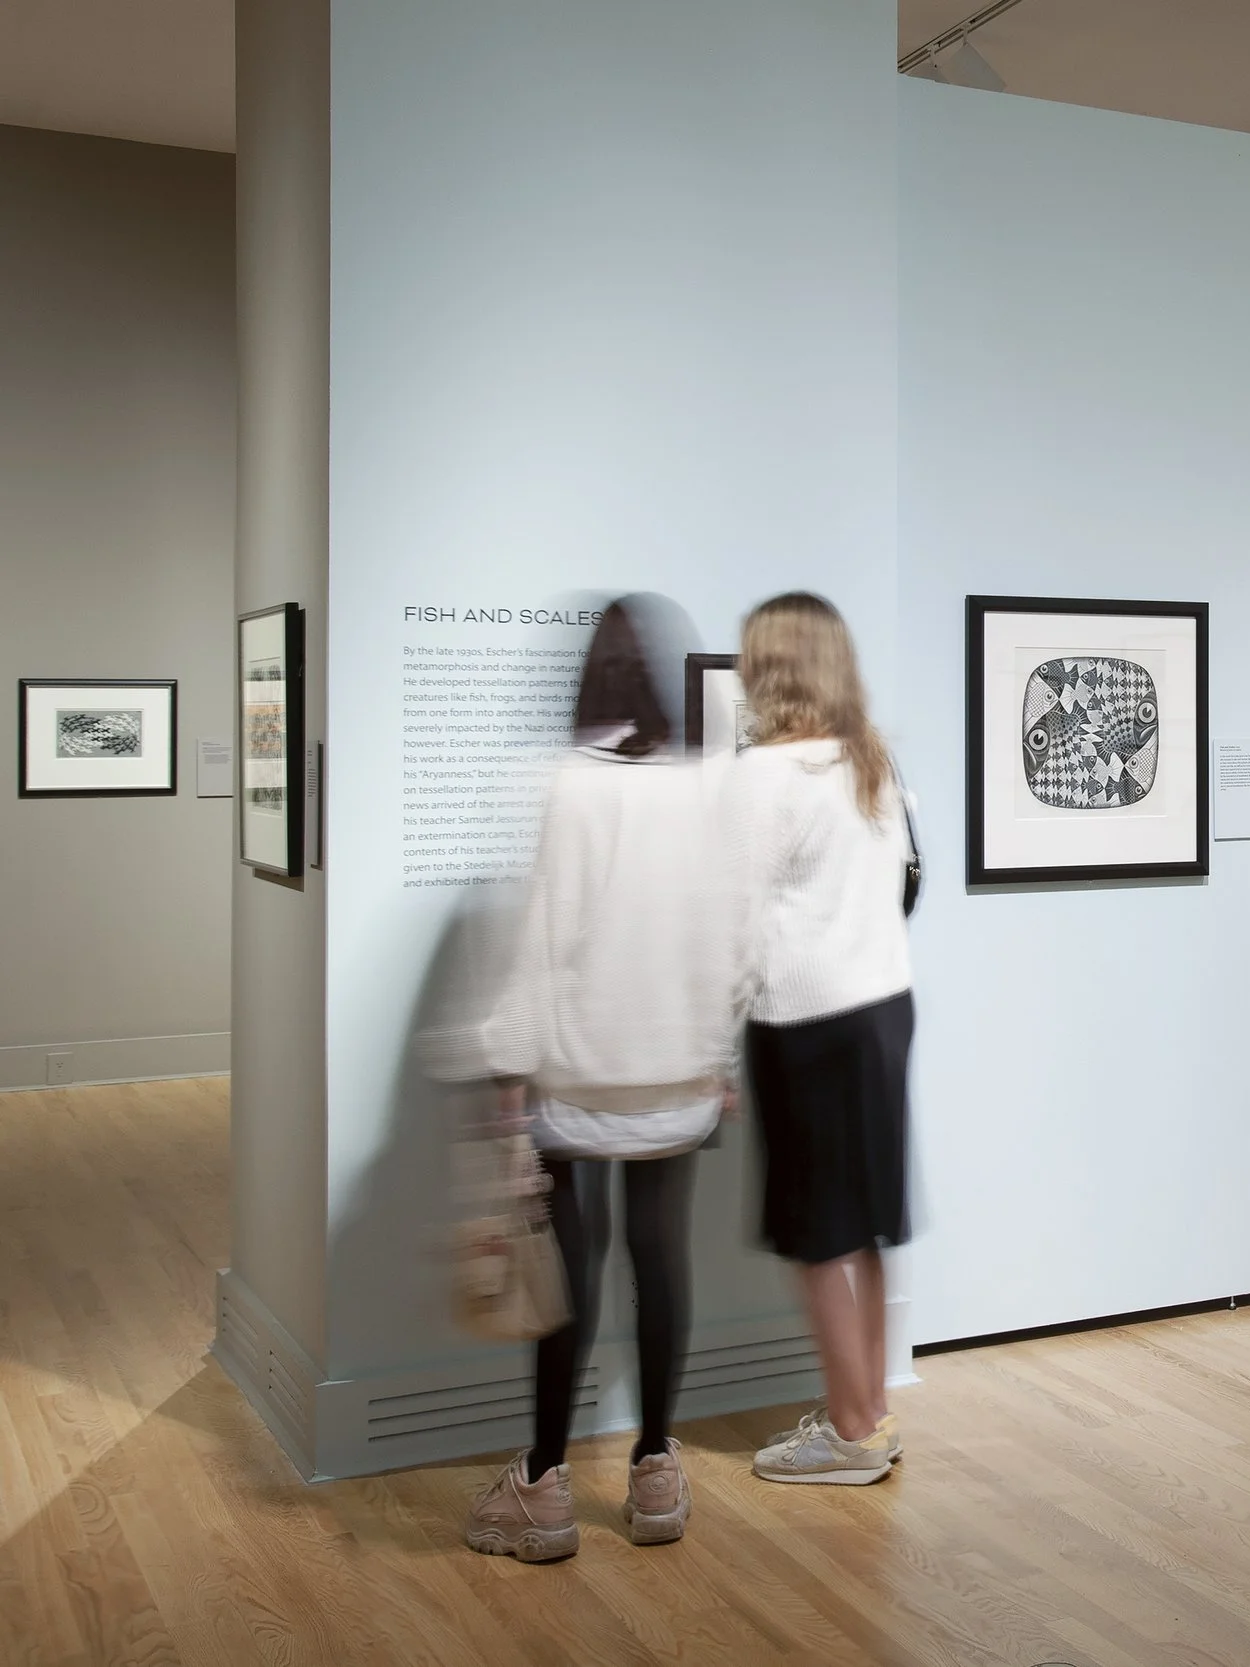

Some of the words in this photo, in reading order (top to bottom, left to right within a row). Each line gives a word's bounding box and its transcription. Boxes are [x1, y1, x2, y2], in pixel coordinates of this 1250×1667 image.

[404, 606, 456, 622] FISH
[462, 608, 513, 624] AND
[520, 609, 604, 626] SCALES
[403, 646, 415, 657] By
[417, 646, 434, 656] the
[436, 647, 455, 656] late
[525, 648, 576, 658] fascination
[403, 662, 479, 673] metamorphosis
[480, 662, 500, 672] and
[501, 663, 537, 675] change
[538, 664, 548, 673] in
[549, 664, 580, 673] nature
[403, 677, 417, 687] He
[419, 677, 471, 689] developed
[473, 678, 527, 688] tessellation
[528, 679, 568, 690] patterns
[403, 692, 449, 702] creatures
[450, 691, 467, 702] like
[518, 693, 537, 703] and
[539, 694, 562, 703] birds
[403, 708, 427, 717] from
[428, 709, 448, 717] one
[449, 707, 473, 717] form
[475, 708, 494, 717] into
[537, 708, 551, 718] His
[553, 708, 577, 718] work
[403, 723, 443, 734] severely
[445, 723, 491, 734] impacted
[492, 723, 505, 734] by
[506, 723, 523, 733] the
[525, 723, 545, 733] Nazi
[449, 738, 481, 748] Escher
[482, 739, 502, 748] was
[503, 739, 553, 749] prevented
[403, 754, 417, 763] his
[419, 754, 445, 763] work
[466, 754, 531, 765] consequence
[403, 769, 417, 778] his
[477, 769, 495, 778] but
[496, 768, 508, 778] he
[403, 786, 416, 795] on
[419, 784, 474, 795] tessellation
[475, 784, 515, 796] patterns
[403, 802, 429, 810] news
[431, 800, 465, 809] arrived
[467, 799, 477, 809] of
[479, 799, 496, 808] the
[403, 816, 417, 825] his
[419, 815, 456, 825] teacher
[458, 815, 494, 824] Samuel
[403, 833, 416, 841] an
[418, 830, 486, 841] extermination
[403, 846, 446, 856] contents
[448, 845, 459, 855] of
[460, 845, 474, 855] his
[403, 862, 431, 875] given
[432, 863, 443, 871] to
[445, 861, 462, 871] the
[403, 877, 422, 888] and
[424, 876, 471, 886] exhibited
[472, 875, 498, 885] there
